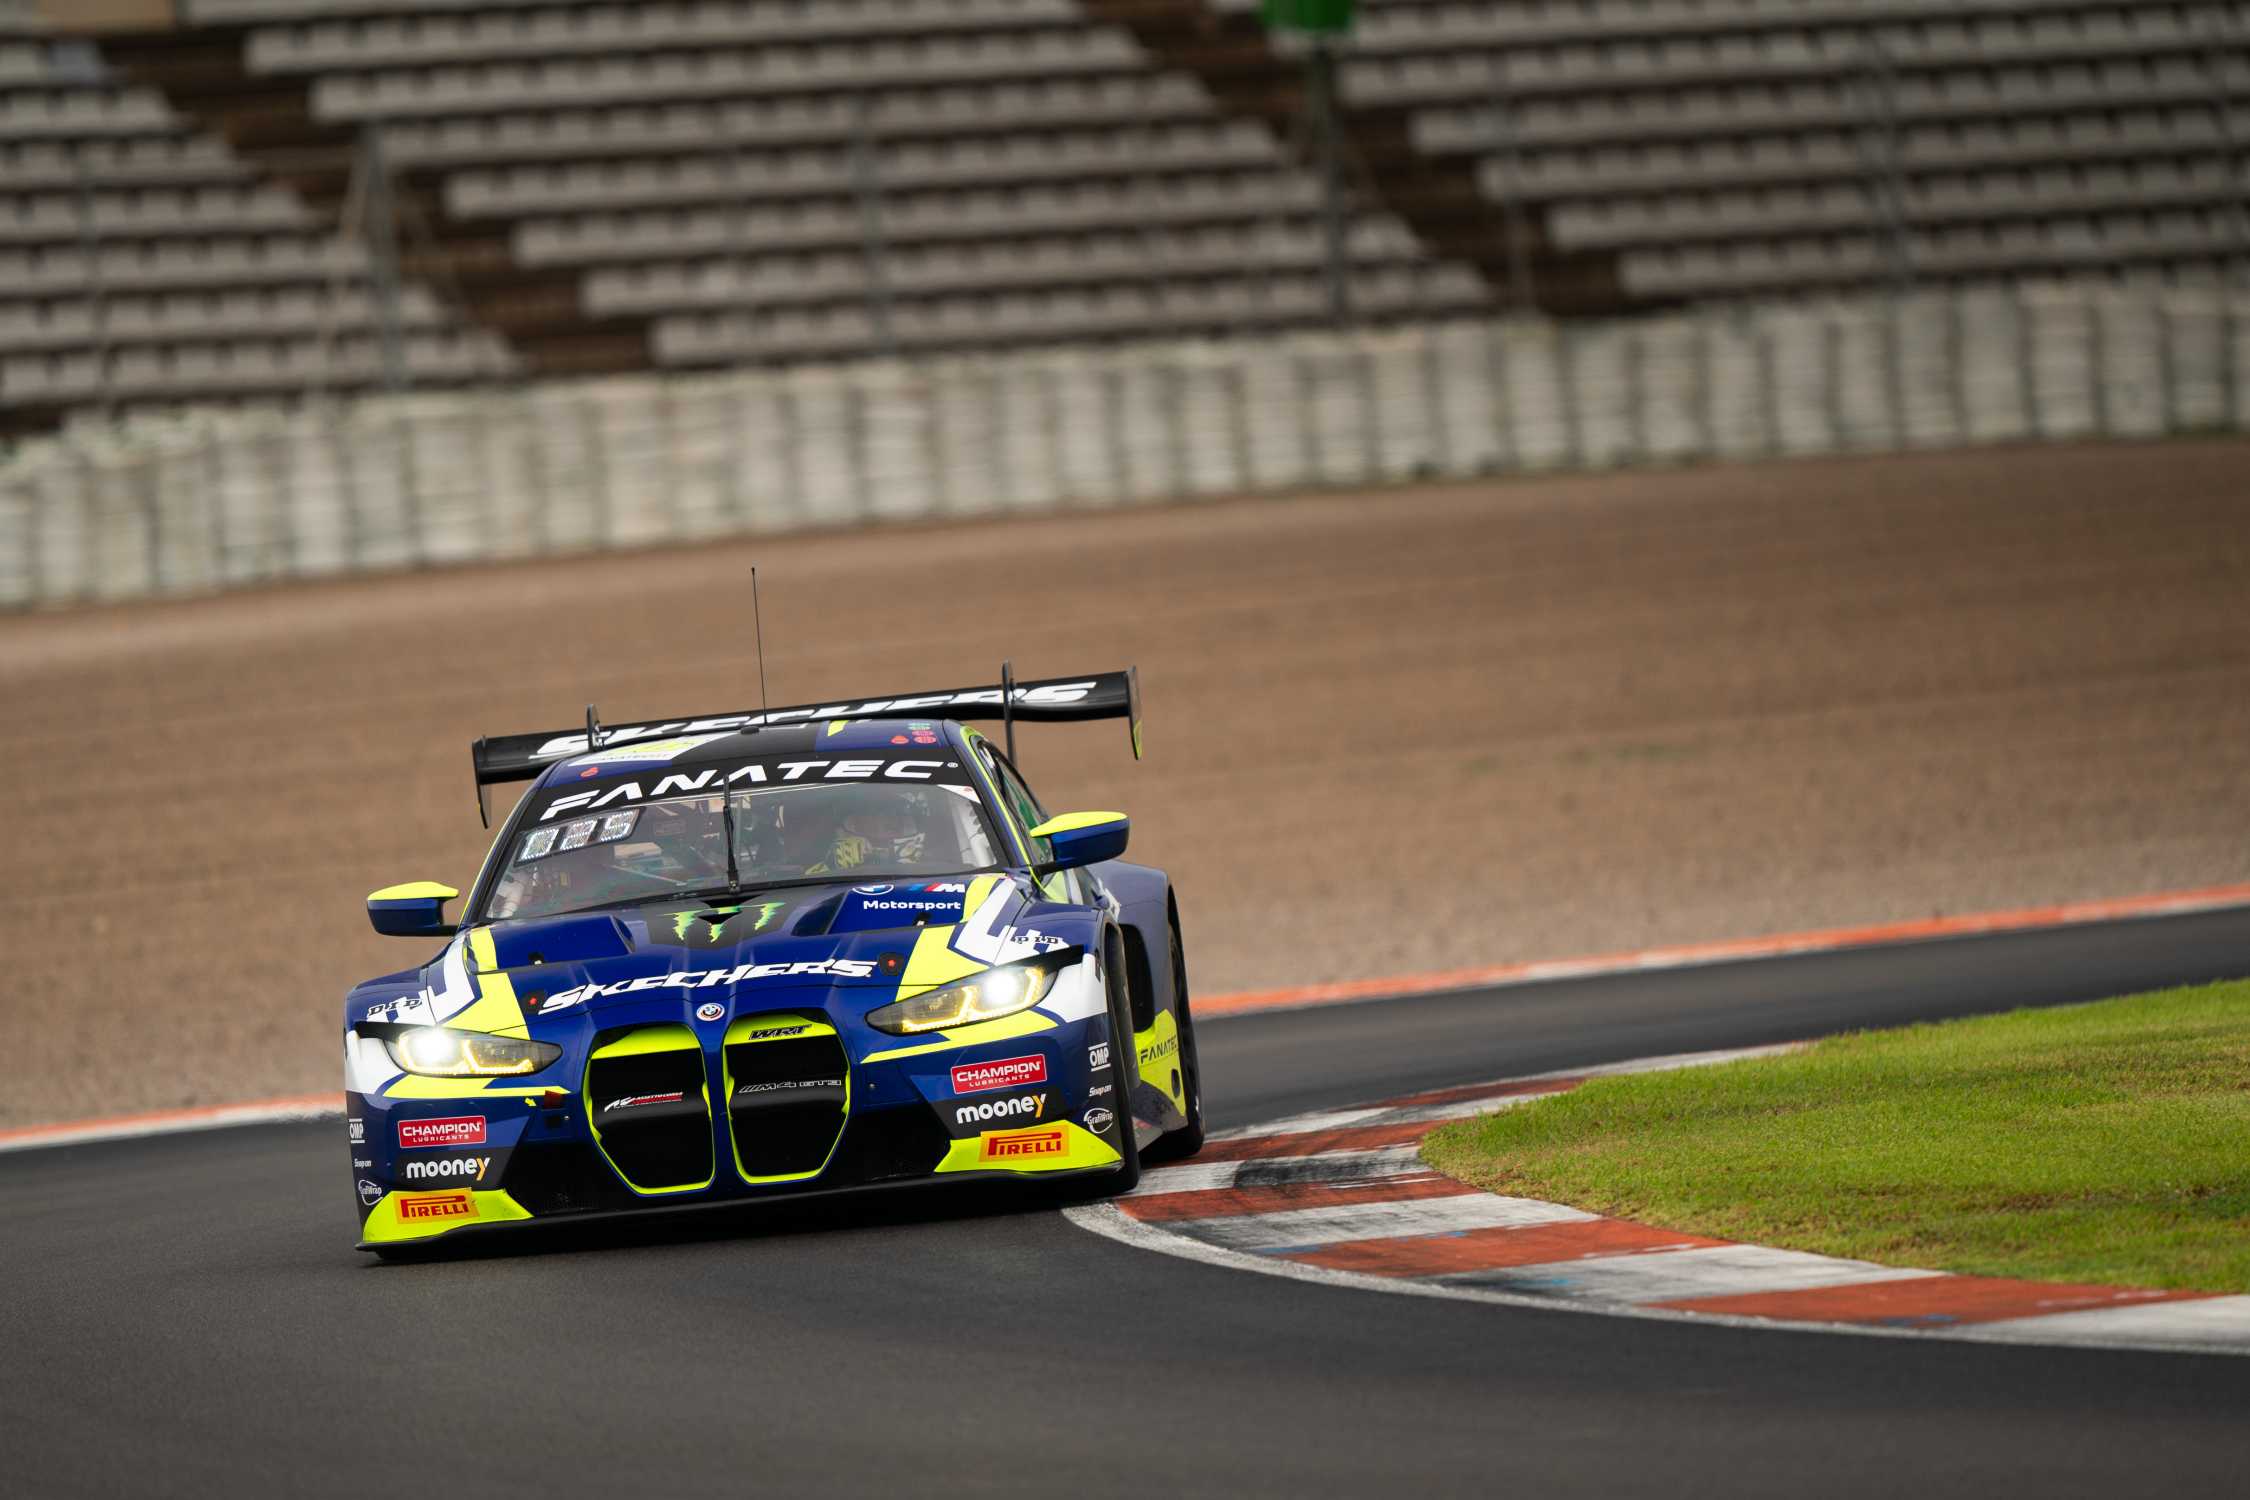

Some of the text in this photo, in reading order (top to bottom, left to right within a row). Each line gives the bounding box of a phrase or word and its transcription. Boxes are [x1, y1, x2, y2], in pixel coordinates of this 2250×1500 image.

[540, 760, 944, 821] FANATEC
[863, 900, 961, 911] Motorsport
[538, 958, 878, 1016] SKECHERS
[749, 1024, 812, 1041] WRT
[1089, 1046, 1110, 1067] OMP
[956, 1060, 1041, 1083] CHAMPION
[969, 1073, 1030, 1088] LUBRICANTS
[956, 1093, 1047, 1124] mooney
[349, 1123, 364, 1139] OMP
[402, 1122, 481, 1138] CHAMPION
[412, 1133, 470, 1143] LUBRICANTS
[988, 1131, 1062, 1156] PIRELLI
[406, 1157, 491, 1181] mooney
[401, 1195, 469, 1218] PIRELLI
